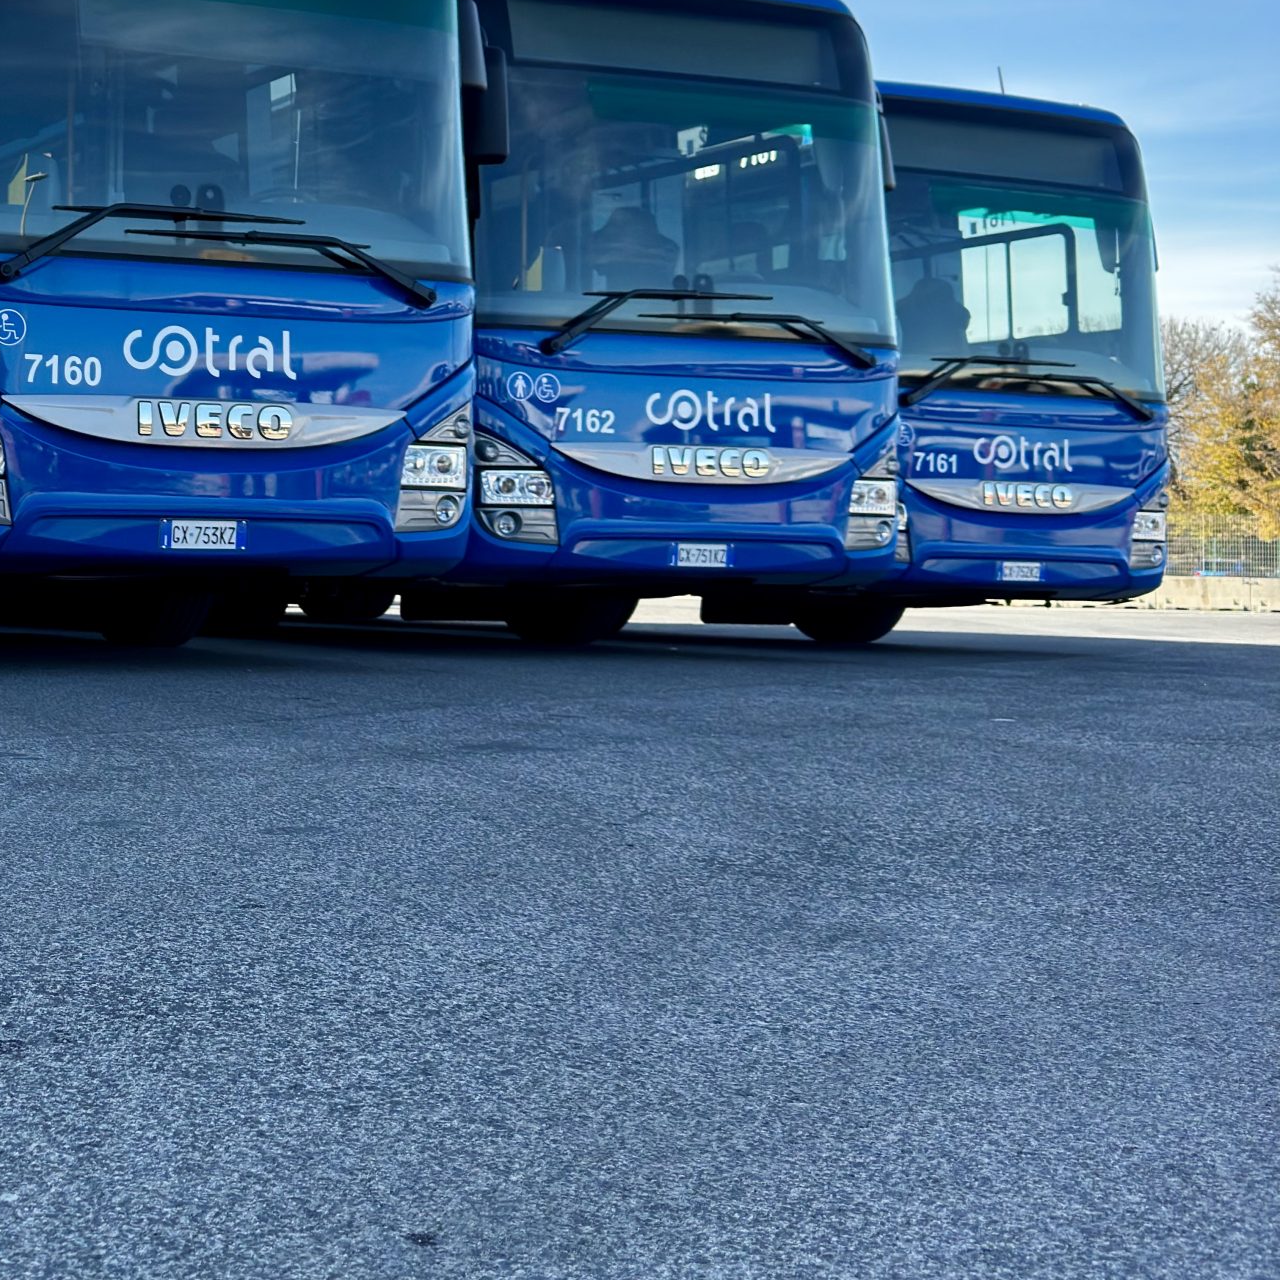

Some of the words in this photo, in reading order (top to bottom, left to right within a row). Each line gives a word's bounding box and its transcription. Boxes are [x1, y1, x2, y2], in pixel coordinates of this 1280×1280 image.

[123, 325, 297, 380] cotral
[24, 353, 102, 387] 7160
[137, 400, 294, 440] IVECO
[556, 406, 616, 435] 7162
[645, 389, 776, 433] cotral
[652, 446, 770, 478] IVECO
[913, 451, 958, 474] 7161
[973, 435, 1073, 472] cotral
[983, 482, 1073, 509] IVECO
